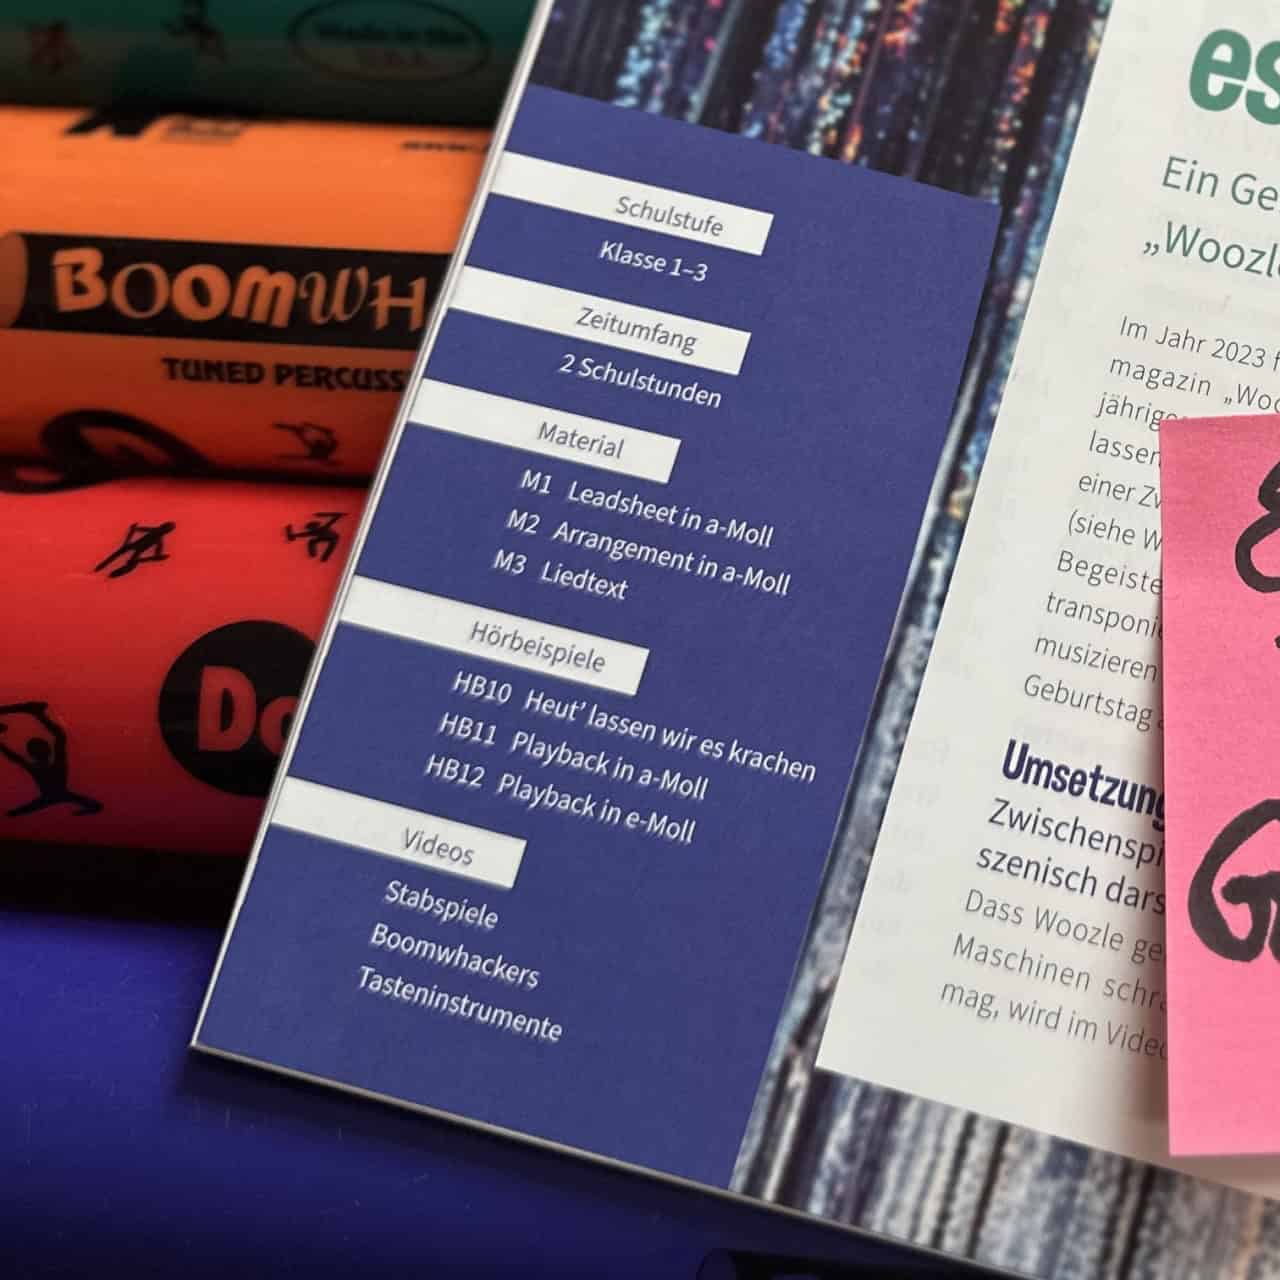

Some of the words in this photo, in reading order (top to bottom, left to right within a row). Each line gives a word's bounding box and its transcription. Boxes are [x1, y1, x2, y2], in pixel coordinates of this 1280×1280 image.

[1161, 154, 1220, 201] Ein
[616, 195, 724, 237] Schulstufe
[599, 240, 667, 274] Klasse
[670, 257, 708, 282] 1–3
[577, 307, 697, 356] Zeitumfang
[1120, 316, 1148, 341] Im
[1155, 326, 1206, 354] Jahr
[1211, 338, 1266, 368] 2023
[161, 358, 265, 385] TUNED
[560, 354, 575, 373] 2
[578, 357, 721, 409] Schulstunden
[1109, 357, 1212, 396] magazin
[538, 422, 624, 460] Material
[521, 469, 551, 494] M1
[568, 481, 677, 525] Leadsheet
[681, 507, 701, 530] in
[705, 516, 775, 548] a-Moll
[1078, 473, 1136, 501] einer
[506, 509, 540, 534] M2
[552, 521, 695, 574] Arrangement
[698, 555, 718, 577] in
[722, 563, 791, 596] a-Moll
[1067, 510, 1136, 546] (siehe
[494, 550, 527, 574] M3
[541, 561, 628, 600] Liedtext
[469, 621, 606, 674] Hörbeispiele
[1034, 634, 1157, 682] musizieren
[452, 671, 512, 703] HB10
[525, 689, 587, 722] Heut’
[588, 708, 656, 743] lassen
[661, 727, 697, 751] wir
[700, 738, 724, 758] es
[729, 740, 817, 783] krachen
[1023, 674, 1152, 732] Geburtstag
[439, 712, 496, 745] HB11
[511, 731, 609, 777] Playback
[613, 756, 633, 781] in
[638, 767, 709, 800] a-Moll
[425, 754, 485, 787] HB12
[496, 773, 597, 819] Playback
[600, 800, 621, 824] in
[625, 810, 697, 845] e-Moll
[403, 828, 474, 866] Videos
[977, 847, 1097, 897] szenisch
[385, 881, 499, 930] Stabspiele
[965, 889, 1024, 925] Dass
[1034, 906, 1123, 951] Woozle
[370, 924, 541, 990] Boomwhackers
[953, 933, 1091, 992] Maschinen
[359, 965, 563, 1043] Tasteninstrumente
[941, 982, 999, 1019] mag,
[1008, 999, 1062, 1031] wird
[1067, 1011, 1097, 1040] im
